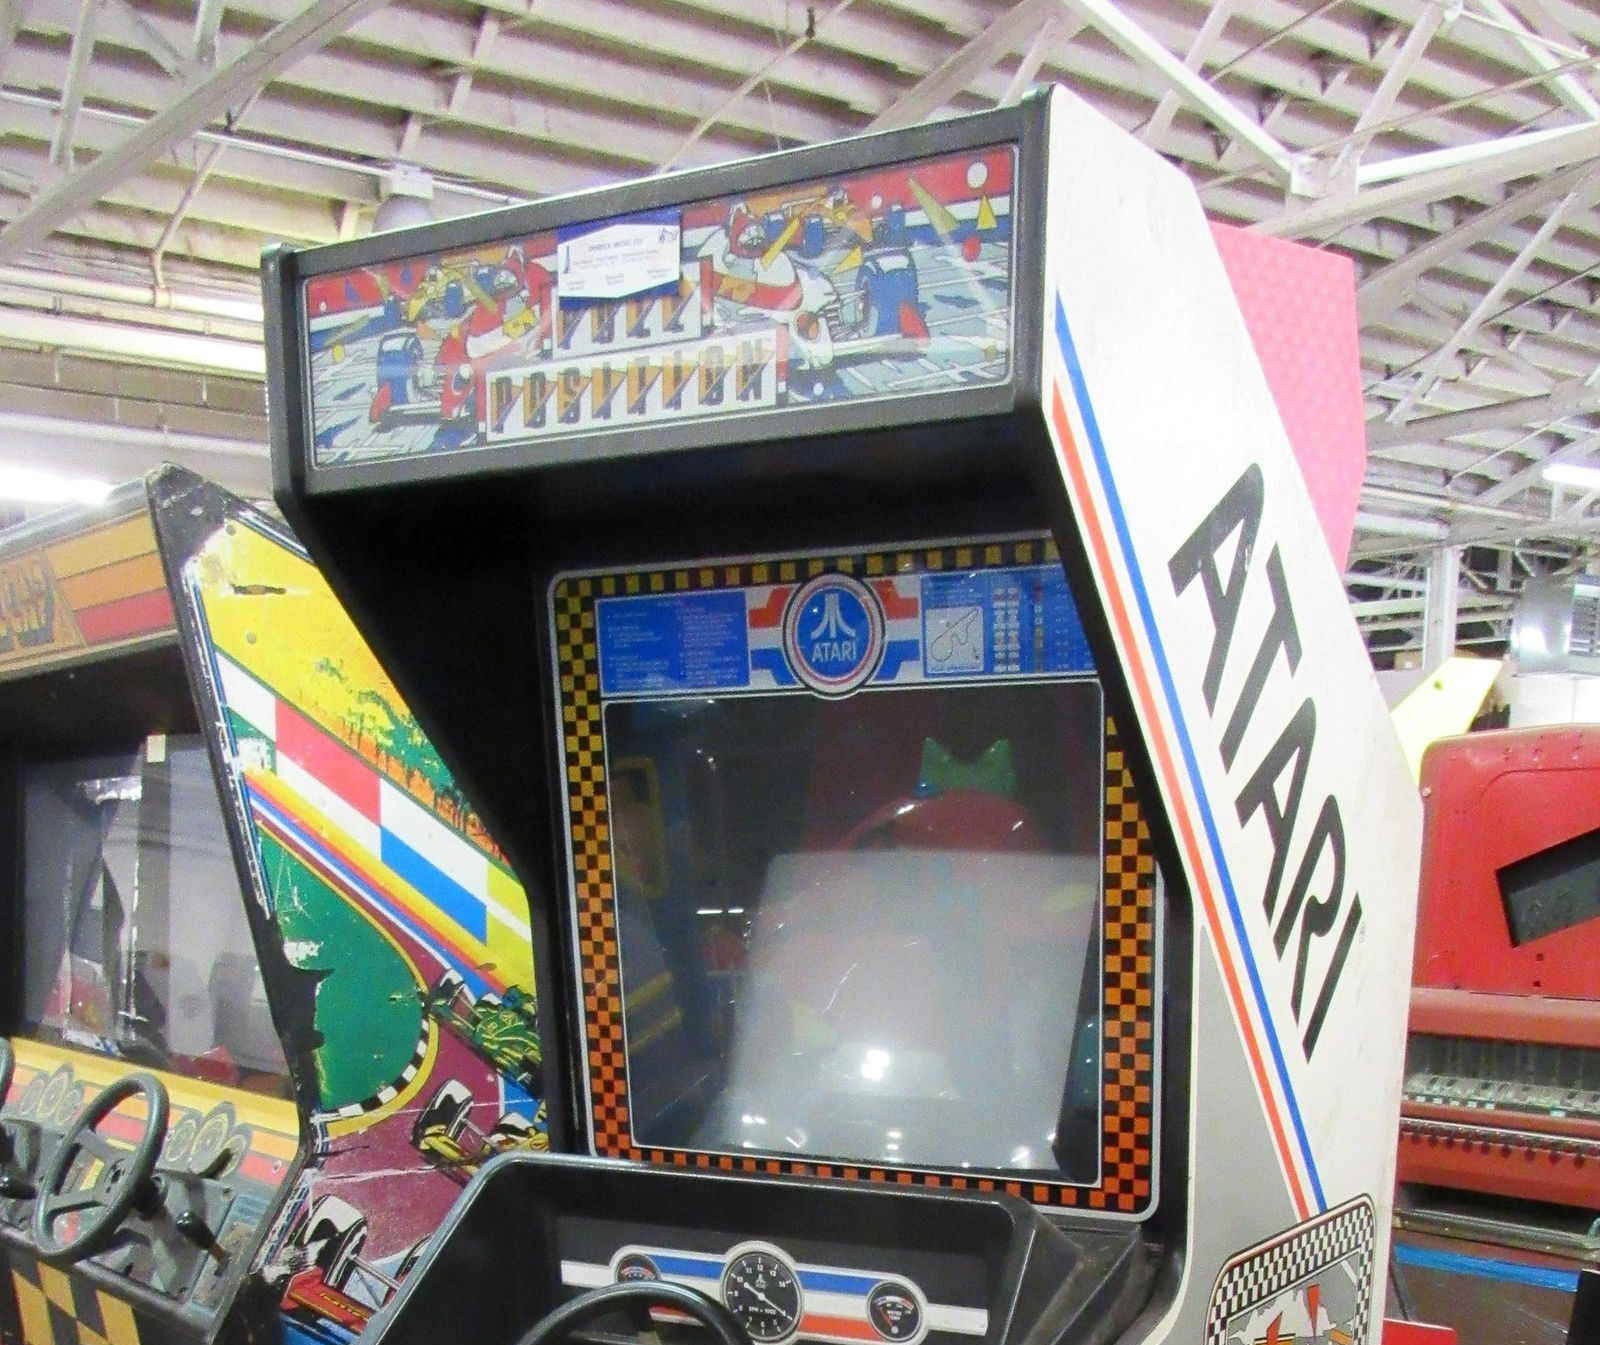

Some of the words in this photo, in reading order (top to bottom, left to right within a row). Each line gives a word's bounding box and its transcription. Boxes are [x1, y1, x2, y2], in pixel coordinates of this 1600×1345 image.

[491, 338, 763, 434] POSITION
[812, 640, 857, 663] ATARI
[1168, 461, 1364, 1066] ATARI
